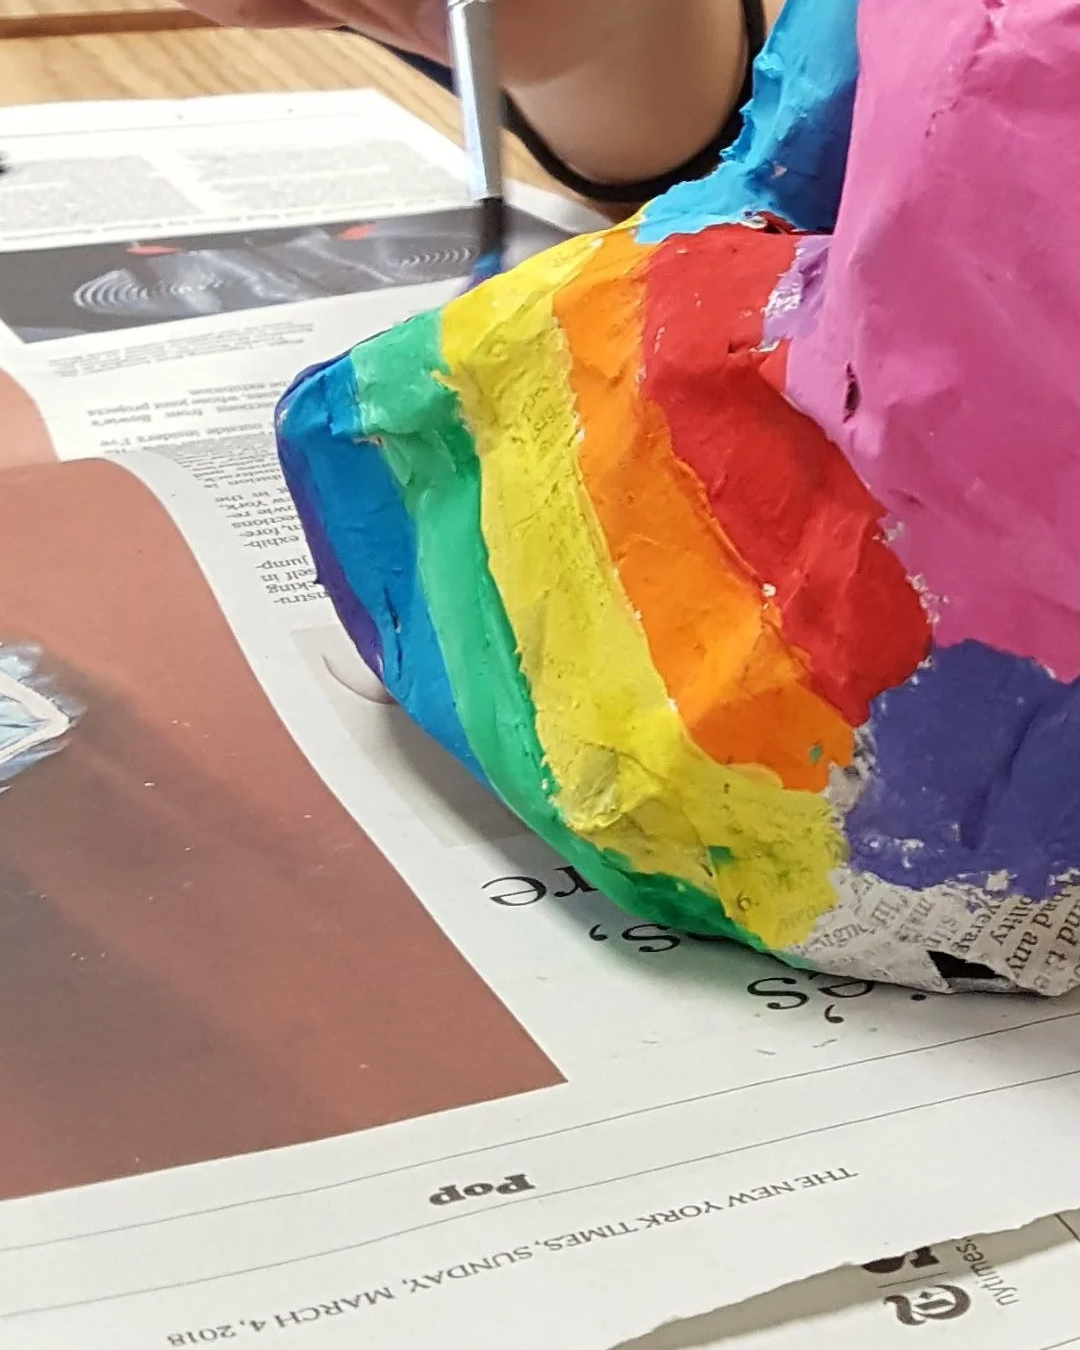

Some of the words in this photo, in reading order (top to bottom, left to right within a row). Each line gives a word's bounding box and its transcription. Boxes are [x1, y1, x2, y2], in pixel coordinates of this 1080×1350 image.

[242, 535, 299, 550] exhib-
[254, 554, 308, 570] jump-
[259, 572, 280, 583] in
[264, 579, 317, 595] cking
[272, 589, 331, 605] nstru-
[428, 1173, 536, 1206] Pop
[794, 1167, 859, 1191] THE
[727, 1179, 795, 1208] NEW
[636, 1200, 723, 1230] YORK
[534, 1220, 639, 1252] TIMES,
[401, 1246, 534, 1293] SUNDAY,
[274, 1286, 398, 1330] MARCH
[166, 1323, 238, 1348] 2018
